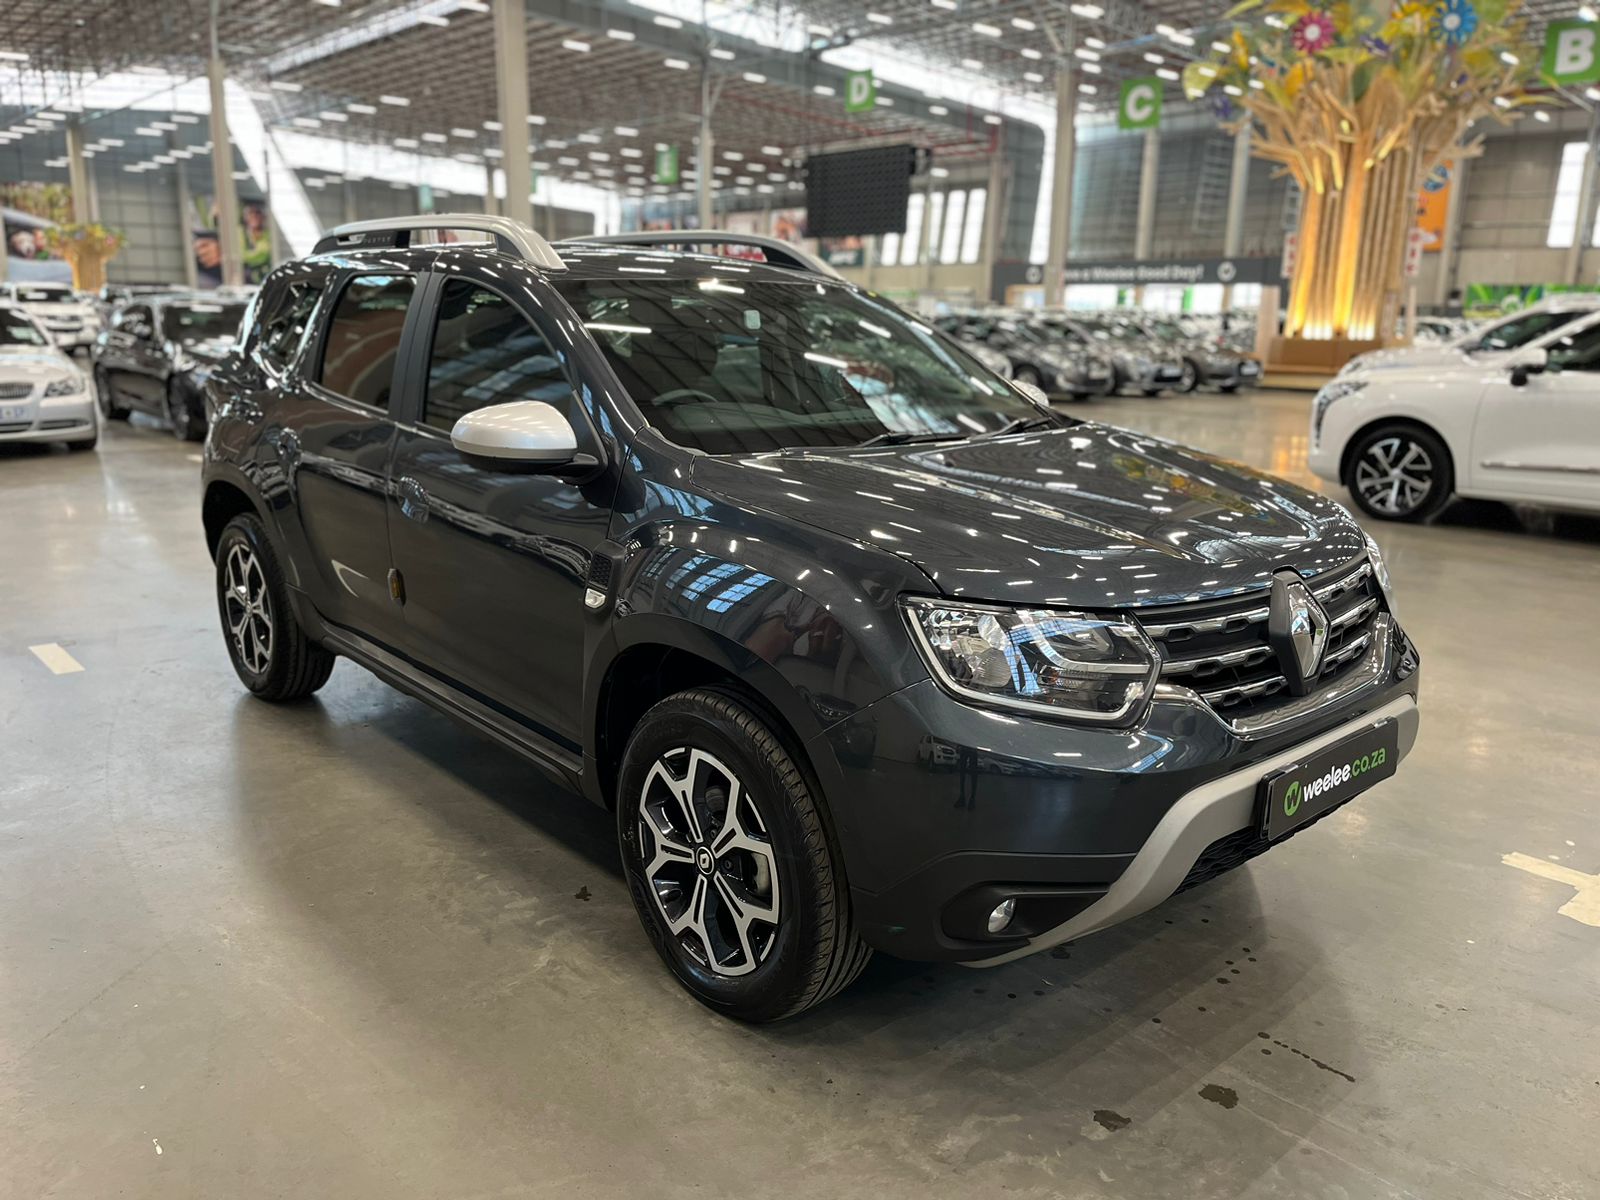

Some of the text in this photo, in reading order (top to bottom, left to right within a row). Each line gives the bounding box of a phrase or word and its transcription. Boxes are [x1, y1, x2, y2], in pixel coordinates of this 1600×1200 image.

[1555, 28, 1596, 75] B
[850, 75, 869, 103] D
[1126, 84, 1154, 121] C
[1303, 748, 1386, 802] weelee.co.za
